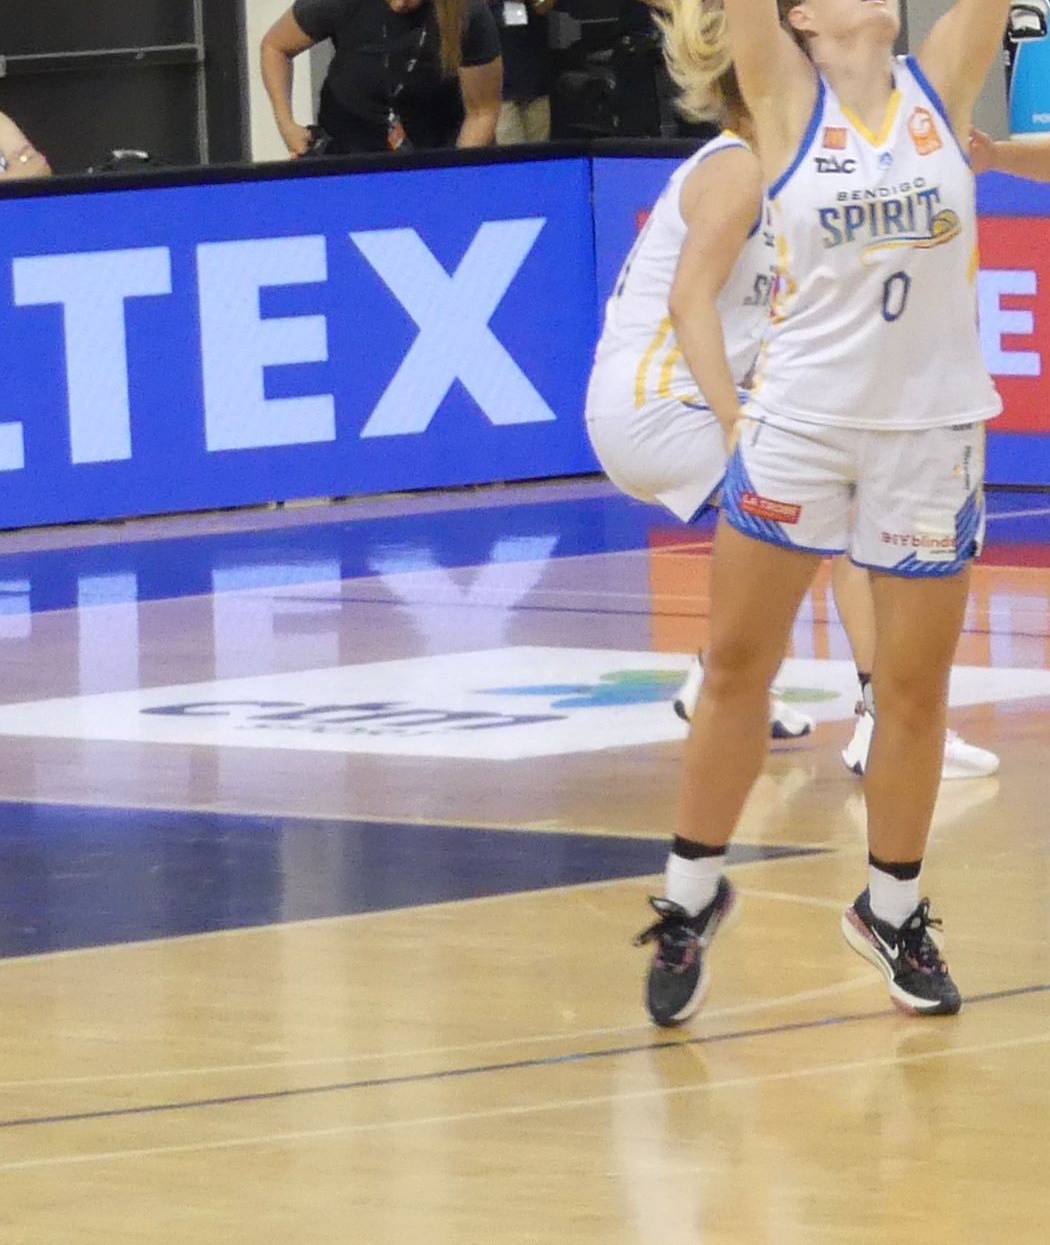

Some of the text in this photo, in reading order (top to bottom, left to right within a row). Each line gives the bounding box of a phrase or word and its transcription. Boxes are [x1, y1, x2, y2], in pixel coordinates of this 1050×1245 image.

[814, 155, 857, 174] TAC
[837, 176, 926, 202] BENDIGO
[816, 187, 942, 249] SPIRIT
[881, 271, 912, 322] 0
